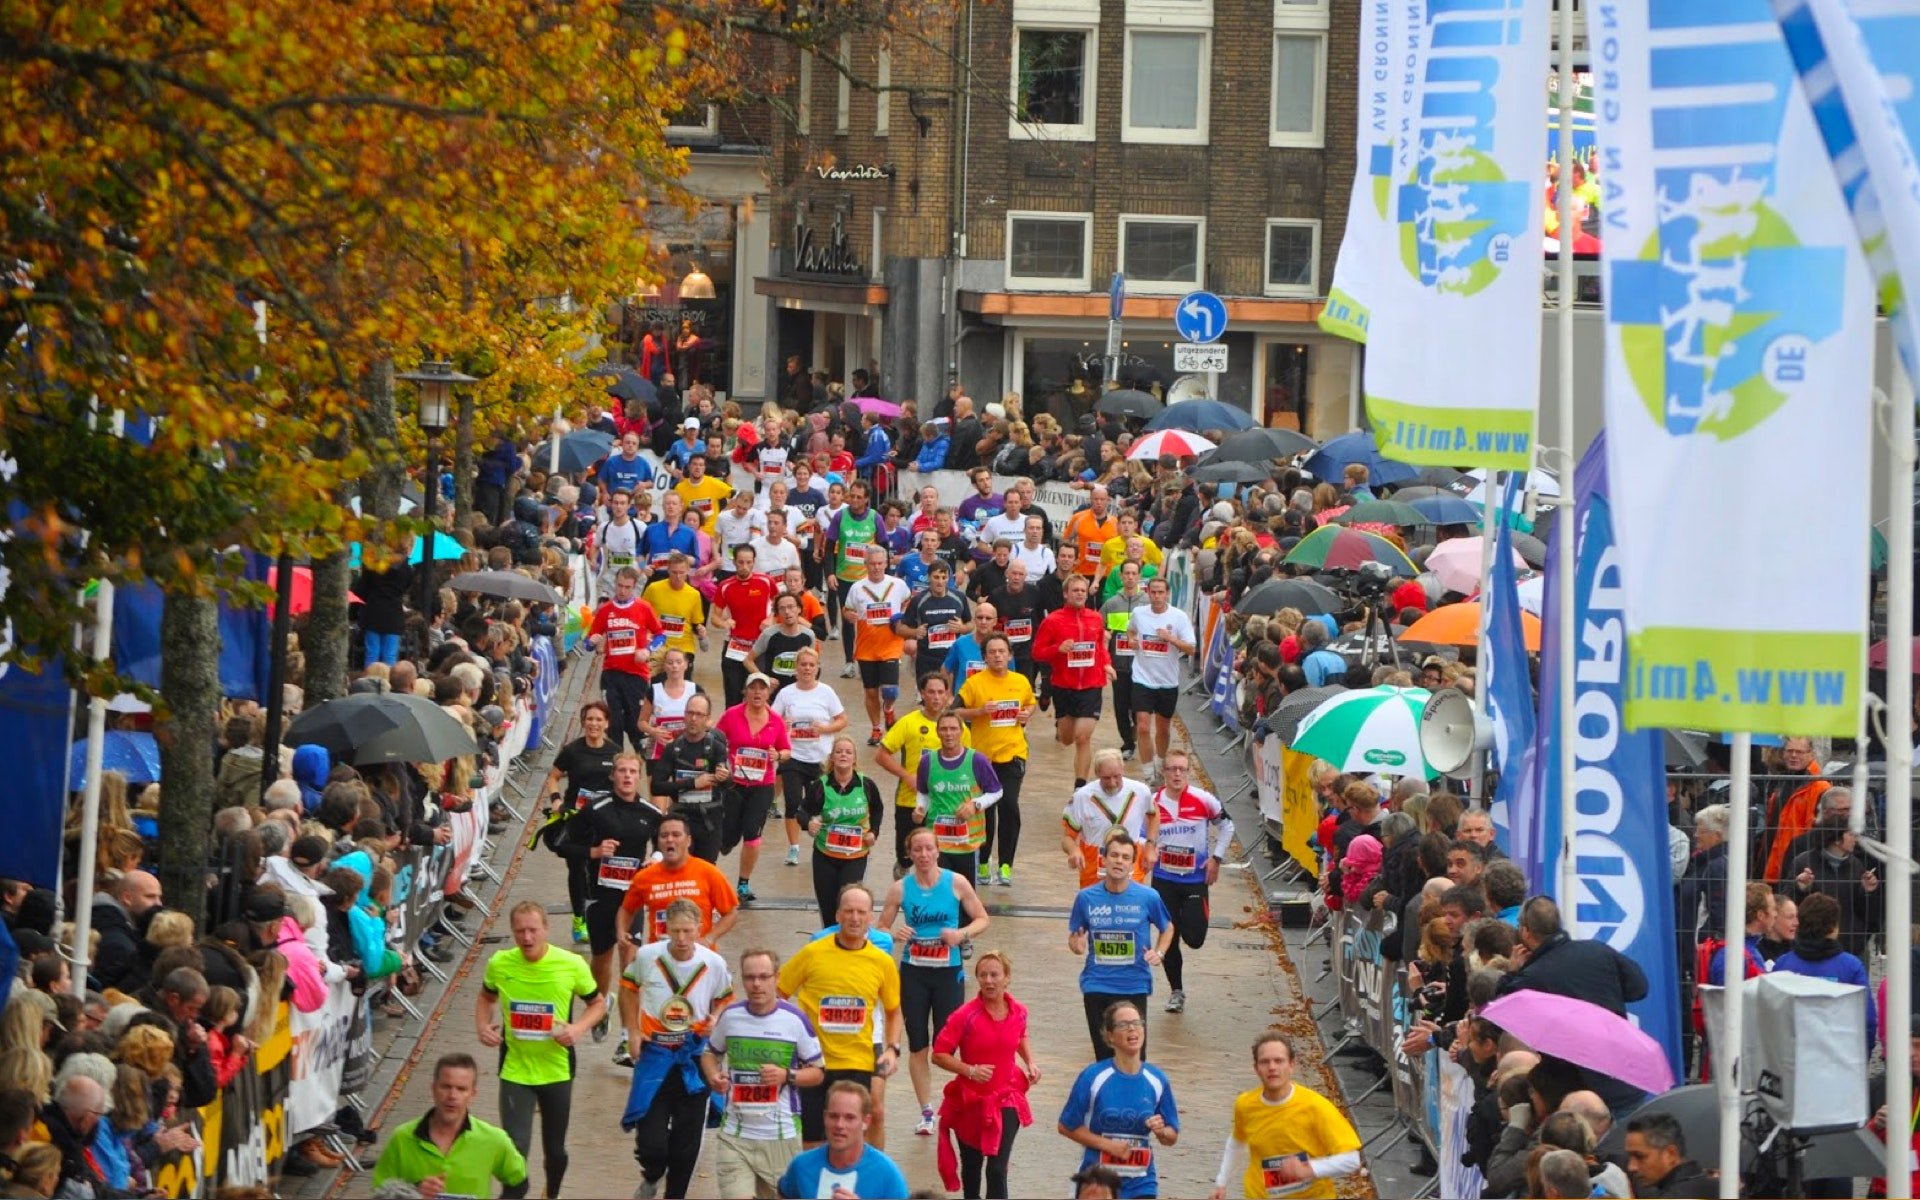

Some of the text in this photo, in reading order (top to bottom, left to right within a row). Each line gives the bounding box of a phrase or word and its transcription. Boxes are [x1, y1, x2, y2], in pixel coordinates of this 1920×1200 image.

[1177, 346, 1226, 355] uitgezonderd
[947, 782, 971, 792] bam
[843, 807, 864, 816] bam
[1100, 933, 1127, 941] menzis
[1099, 942, 1129, 956] 4579
[828, 997, 858, 1006] menzis
[516, 1003, 547, 1012] menzis
[739, 1073, 761, 1083] menz
